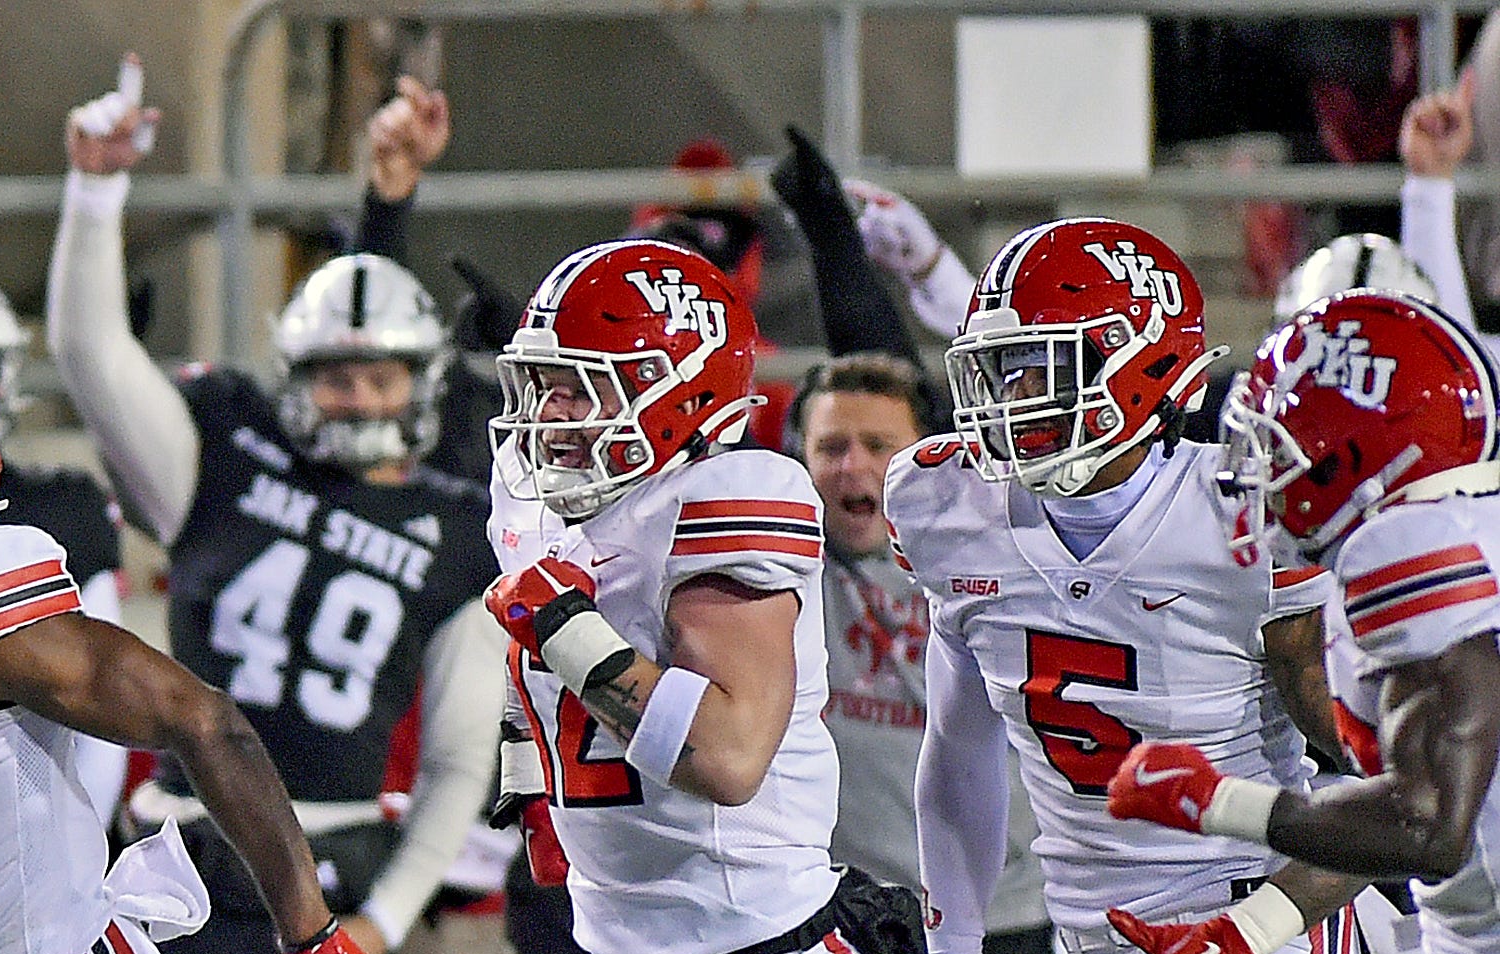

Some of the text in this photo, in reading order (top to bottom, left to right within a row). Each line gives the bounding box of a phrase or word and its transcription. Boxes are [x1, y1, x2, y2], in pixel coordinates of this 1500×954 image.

[624, 268, 728, 350] WKU
[1081, 240, 1184, 318] WKU
[1300, 319, 1399, 410] WKU
[320, 509, 434, 593] STATE
[210, 538, 405, 732] 49
[1017, 627, 1142, 799] 5
